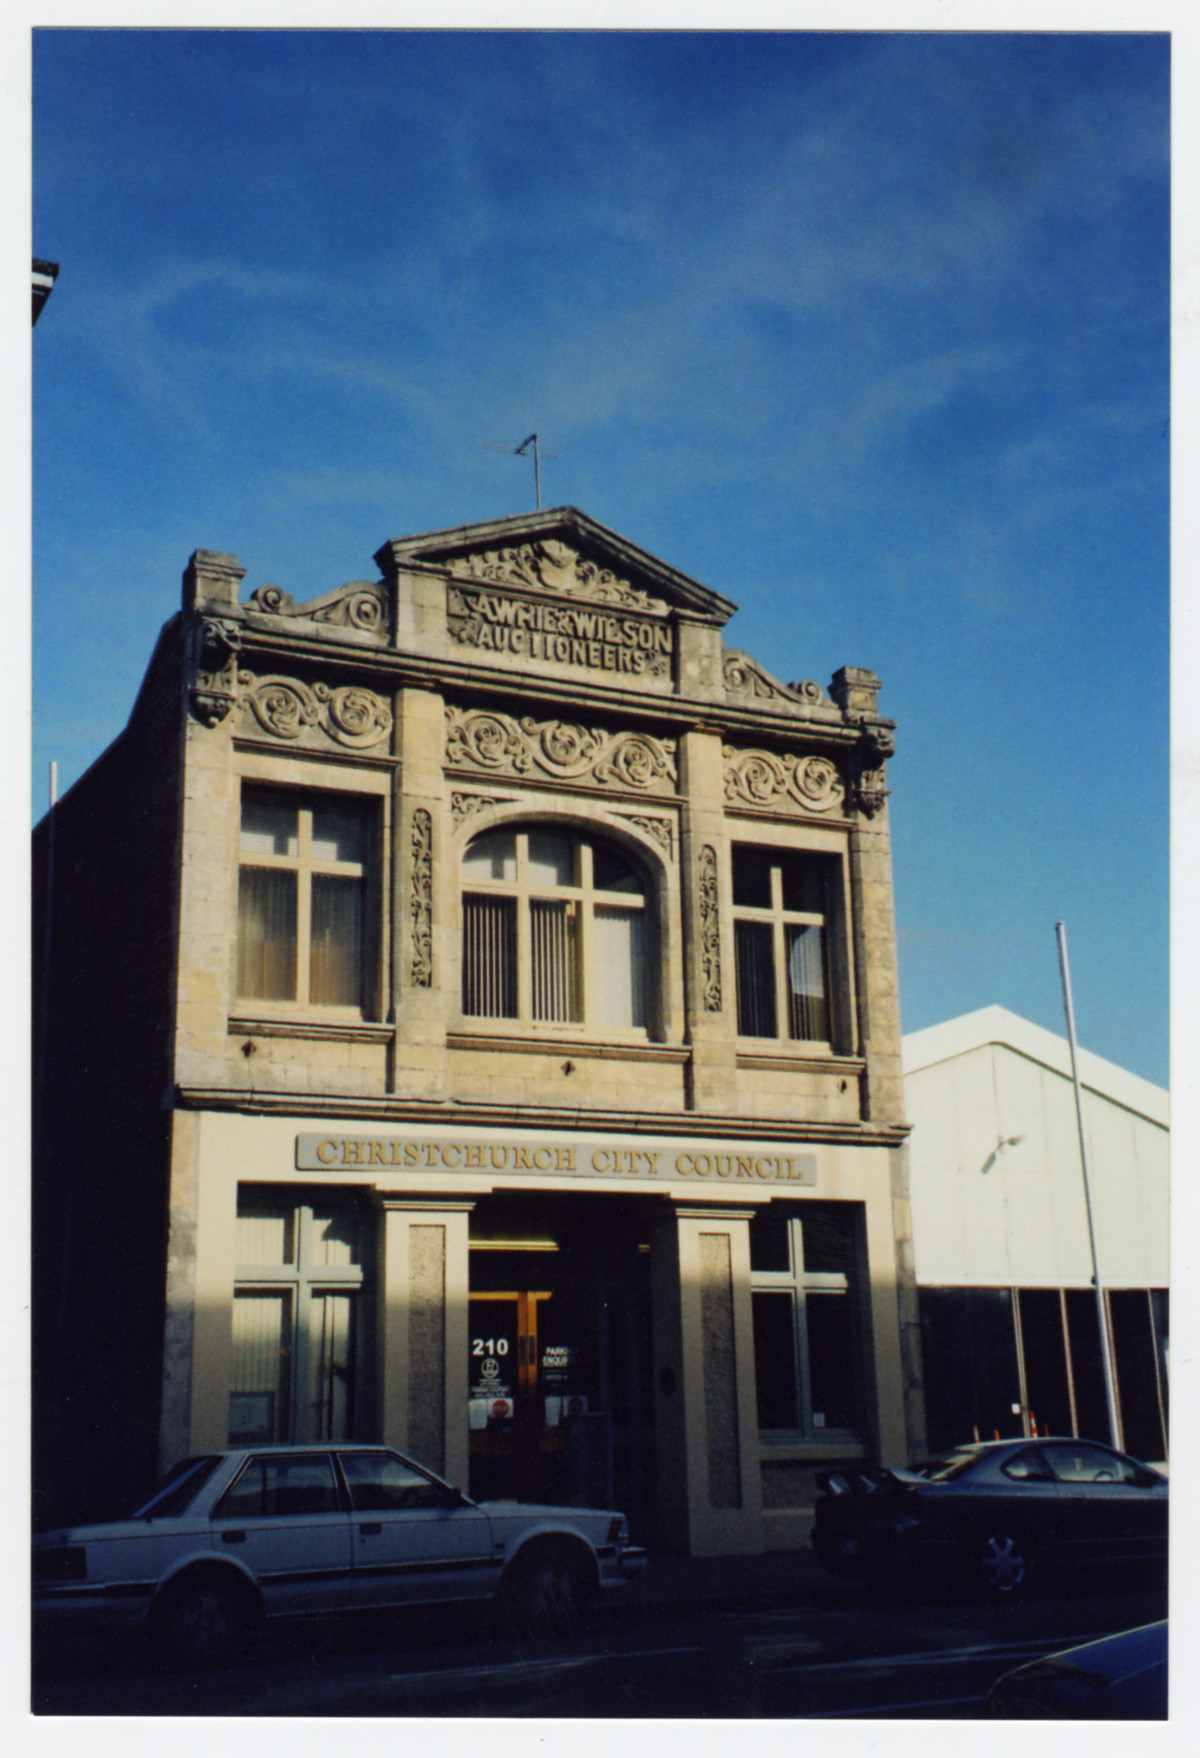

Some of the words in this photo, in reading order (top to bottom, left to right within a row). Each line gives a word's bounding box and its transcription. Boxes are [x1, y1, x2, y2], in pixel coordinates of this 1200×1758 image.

[476, 623, 646, 674] AUCTIONEERS
[316, 1138, 577, 1170] CHRISTCHURCH
[591, 1150, 661, 1174] CITY
[675, 1152, 803, 1180] COUNCIL
[472, 1338, 509, 1356] 210
